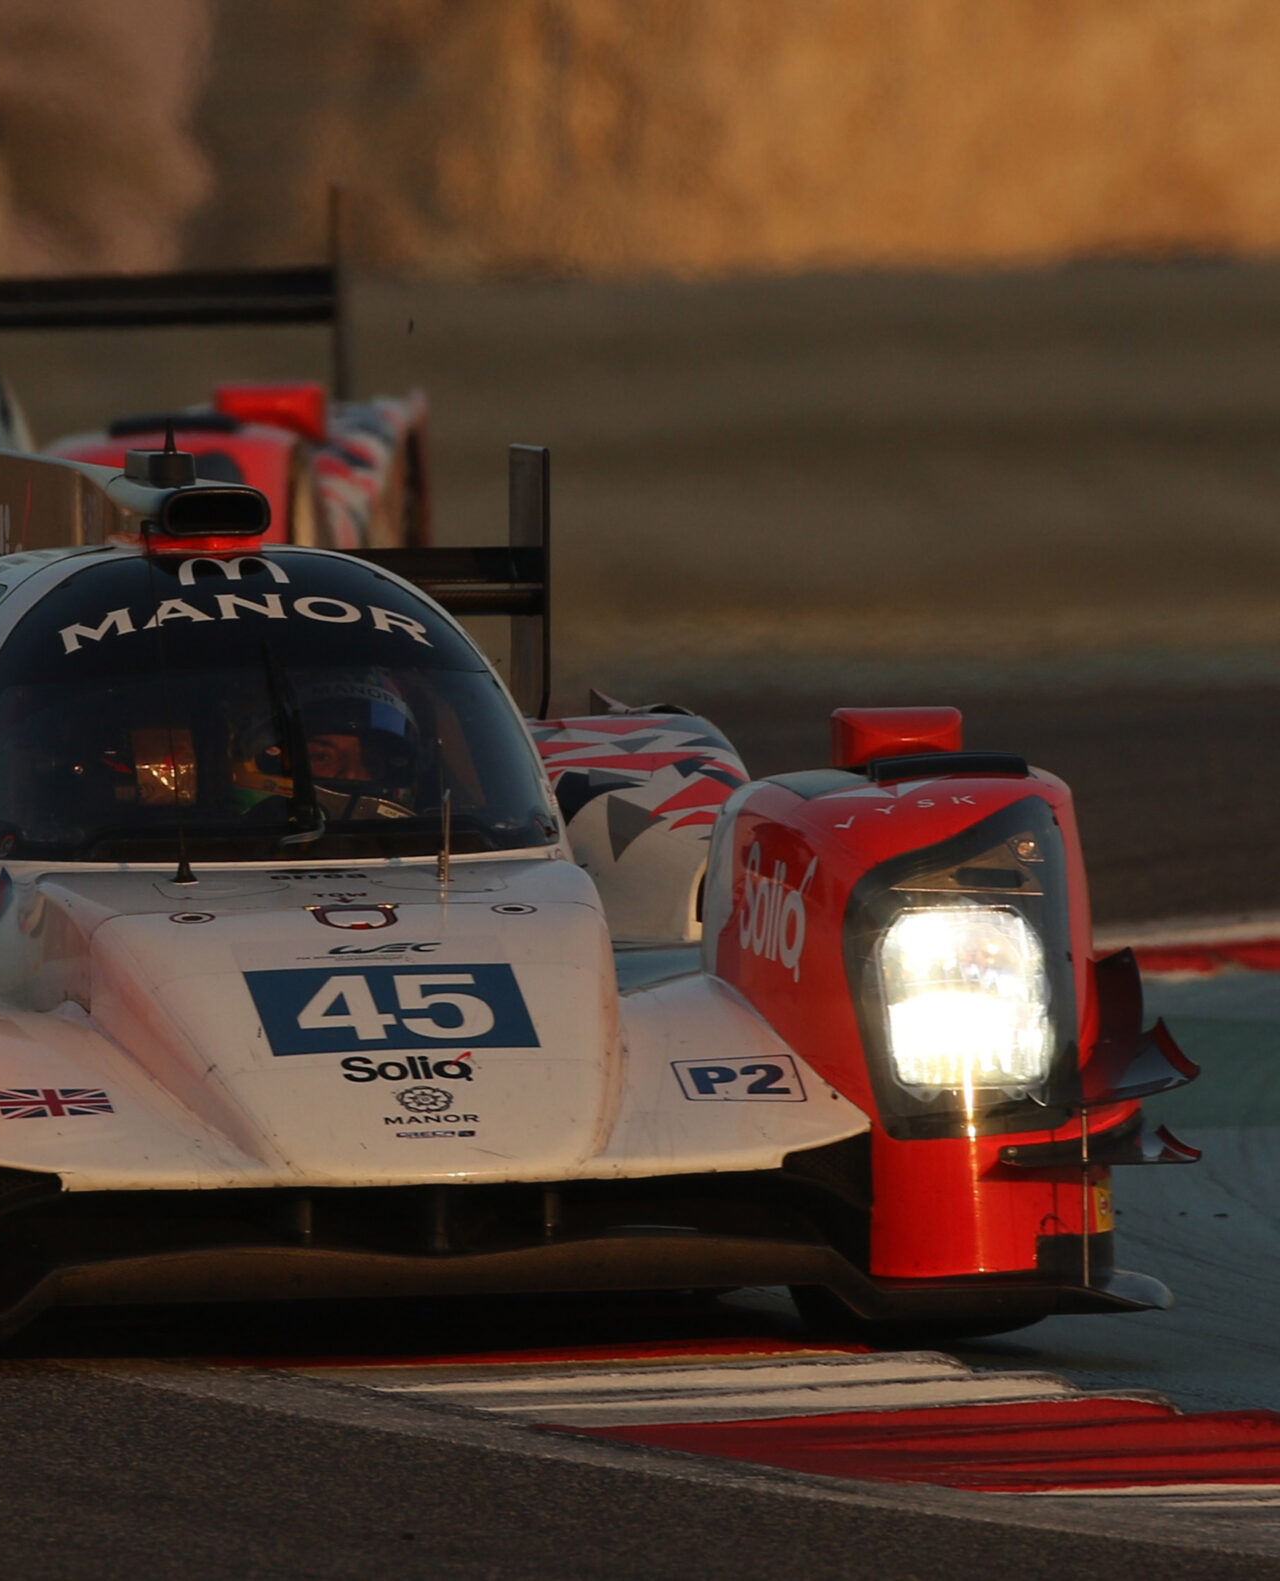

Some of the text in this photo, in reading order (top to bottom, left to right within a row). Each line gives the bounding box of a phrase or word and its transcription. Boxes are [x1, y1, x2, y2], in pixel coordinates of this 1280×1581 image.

[57, 593, 434, 655] MANOR
[328, 942, 442, 955] WEC
[295, 973, 496, 1042] 45
[688, 1063, 789, 1095] P2
[383, 1114, 480, 1125] MANOR
